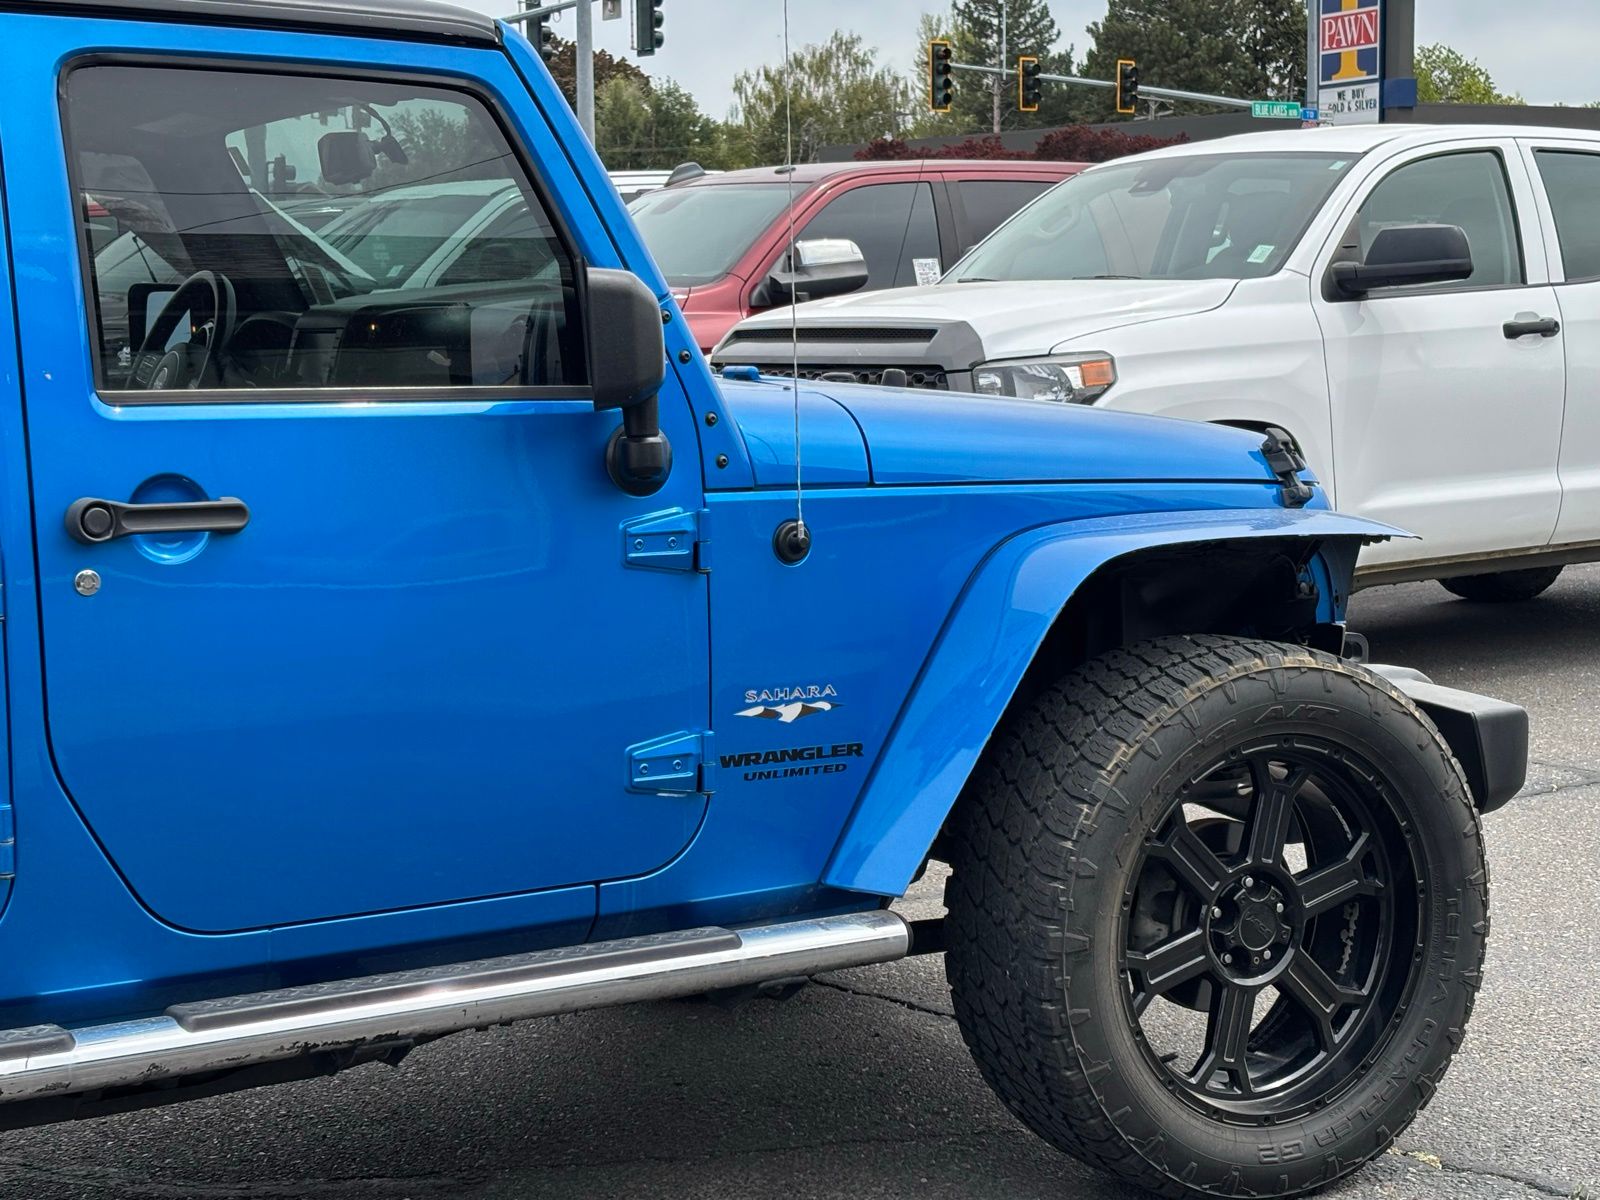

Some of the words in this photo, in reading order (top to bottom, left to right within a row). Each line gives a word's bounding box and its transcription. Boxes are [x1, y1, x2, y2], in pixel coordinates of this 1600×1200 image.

[1323, 12, 1377, 50] PAWN
[1337, 90, 1346, 101] WE
[1352, 88, 1365, 99] BUY
[1270, 104, 1287, 116] LAKES
[1355, 98, 1377, 111] SILVER
[745, 684, 837, 703] SAHARA
[719, 743, 864, 769] WRANGLER
[743, 763, 848, 782] UNLIMITED
[1257, 1140, 1305, 1165] G2
